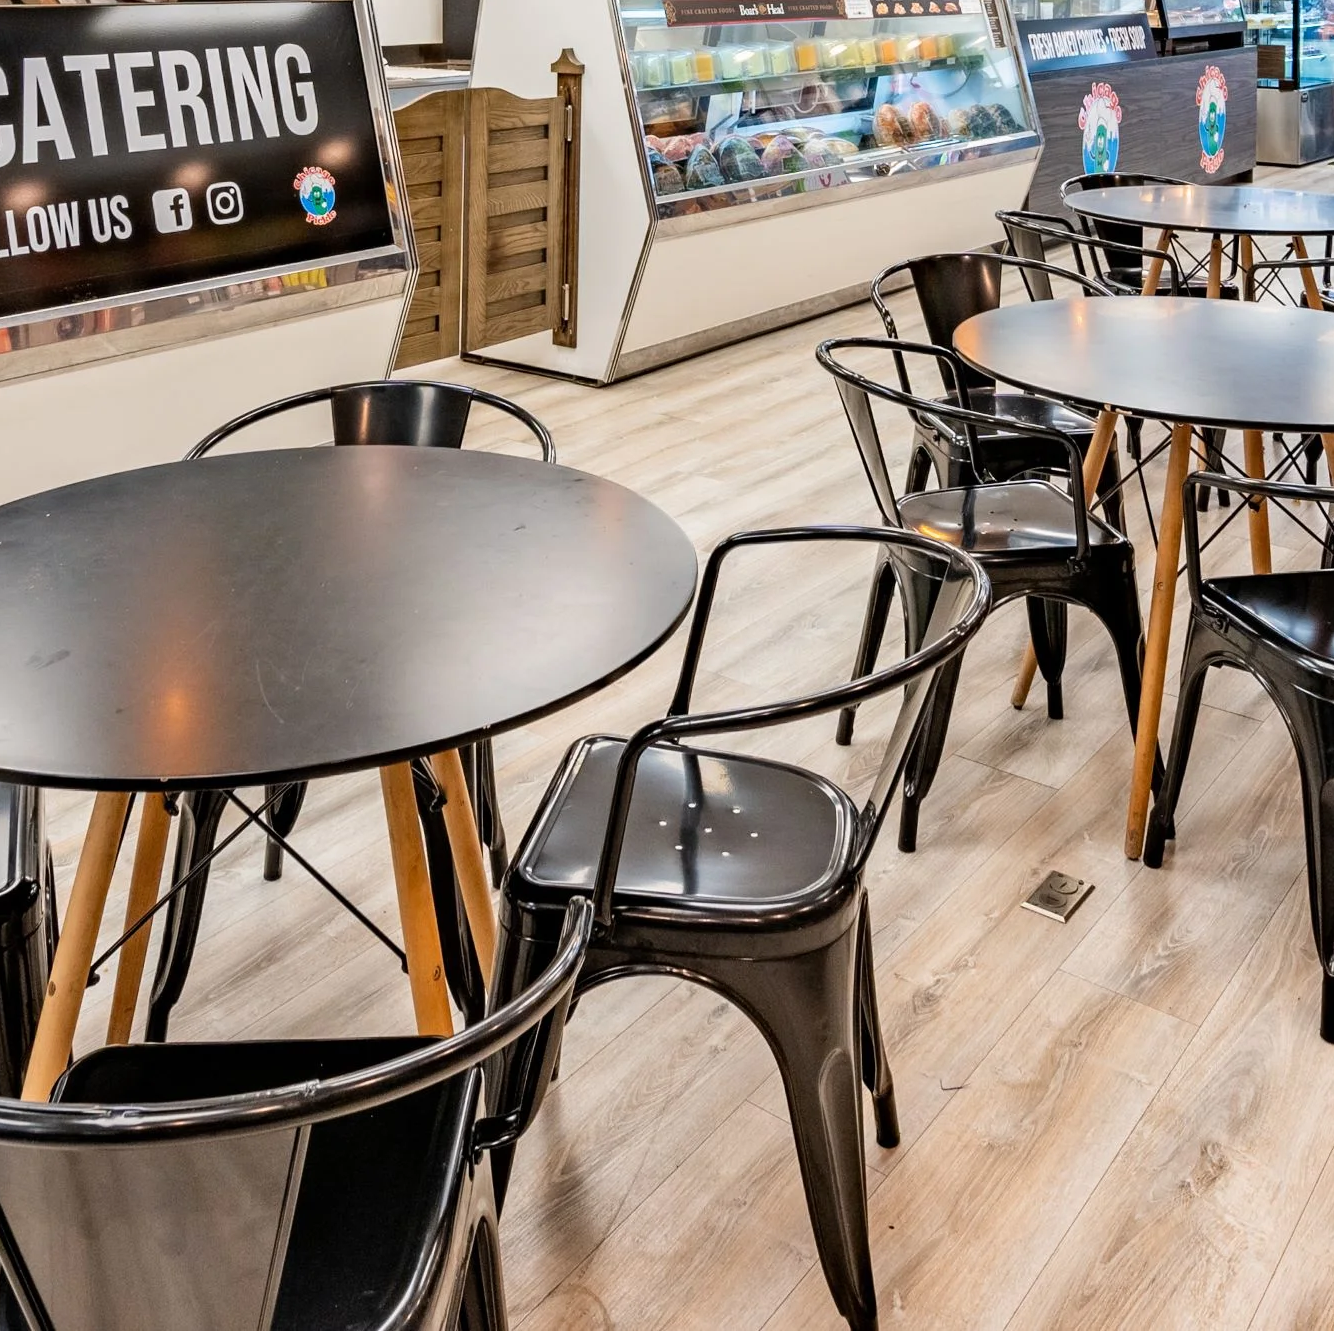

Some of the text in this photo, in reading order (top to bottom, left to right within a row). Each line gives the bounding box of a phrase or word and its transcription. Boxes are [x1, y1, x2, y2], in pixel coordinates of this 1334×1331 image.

[739, 3, 759, 16] Boar's
[767, 2, 785, 15] Head
[1028, 25, 1147, 61] FRESH BAKED COOKIES FRESH SOUP
[1195, 65, 1229, 107] Chicago
[293, 166, 336, 190] Chicago
[91, 193, 134, 244] US
[305, 210, 337, 226] Pickle
